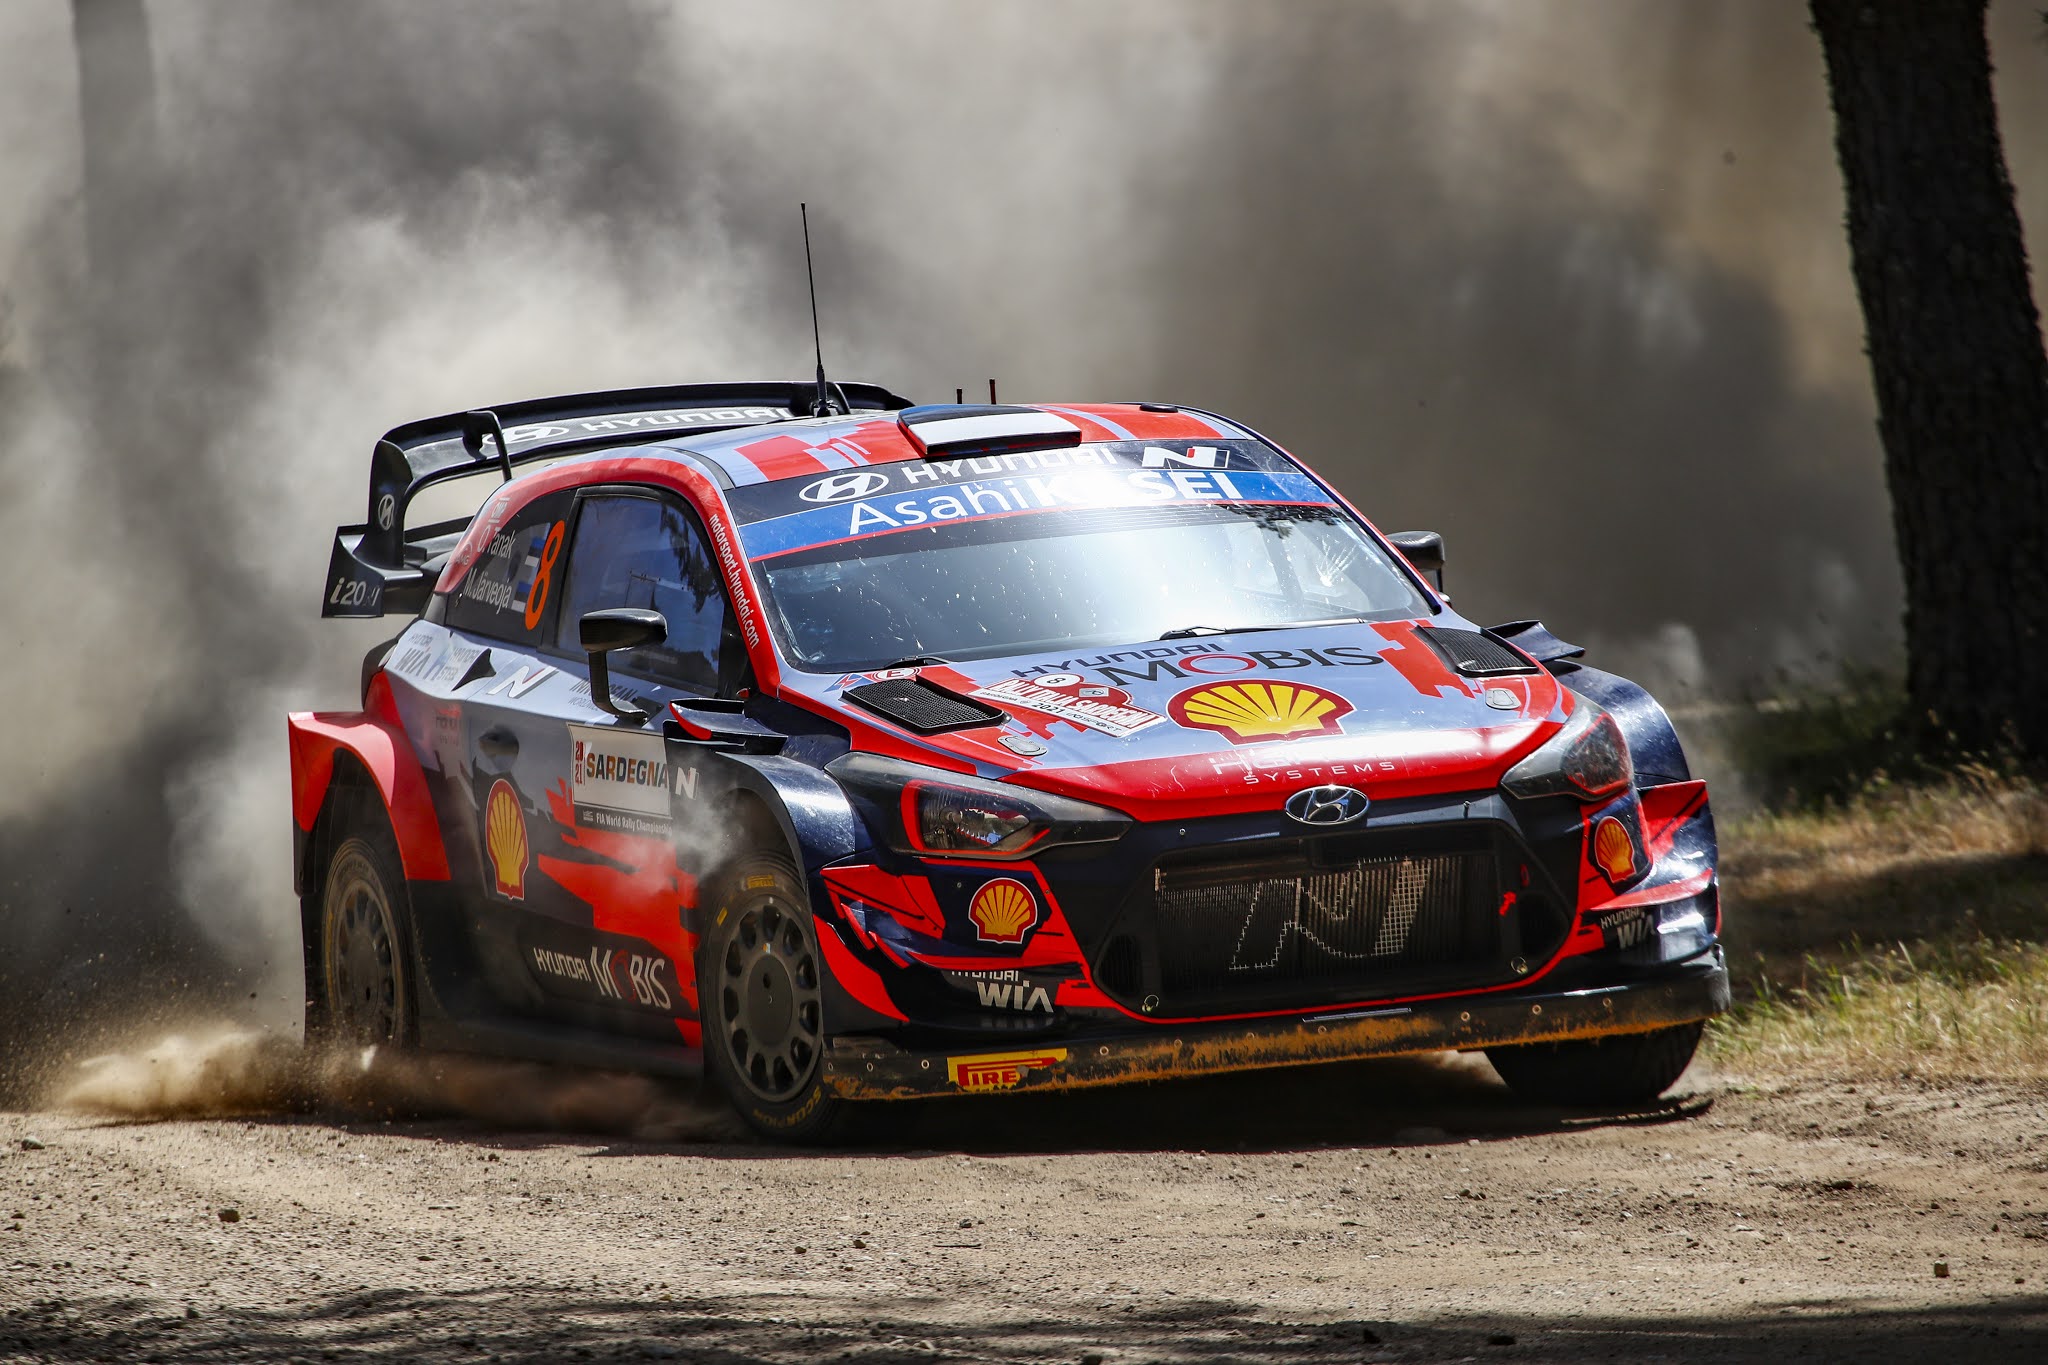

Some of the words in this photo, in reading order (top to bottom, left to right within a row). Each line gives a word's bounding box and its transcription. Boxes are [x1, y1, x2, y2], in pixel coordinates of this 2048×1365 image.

[580, 407, 794, 432] HYUNDAI
[901, 447, 1118, 484] HYUNDAI
[524, 520, 566, 631] 8
[709, 513, 760, 650] motorsport.hyundai.com
[1011, 643, 1226, 678] HYUNDAI
[1092, 647, 1385, 687] MOBIS
[1032, 703, 1065, 714] 2021
[586, 752, 669, 789] SARDEGNA
[1243, 761, 1395, 785] SYSTEMS
[595, 812, 606, 825] FIA
[605, 813, 621, 827] World
[622, 816, 636, 832] Rally
[533, 947, 591, 982] HYUNDAI
[590, 946, 672, 1010] MOBIS
[977, 979, 1054, 1013] WIA
